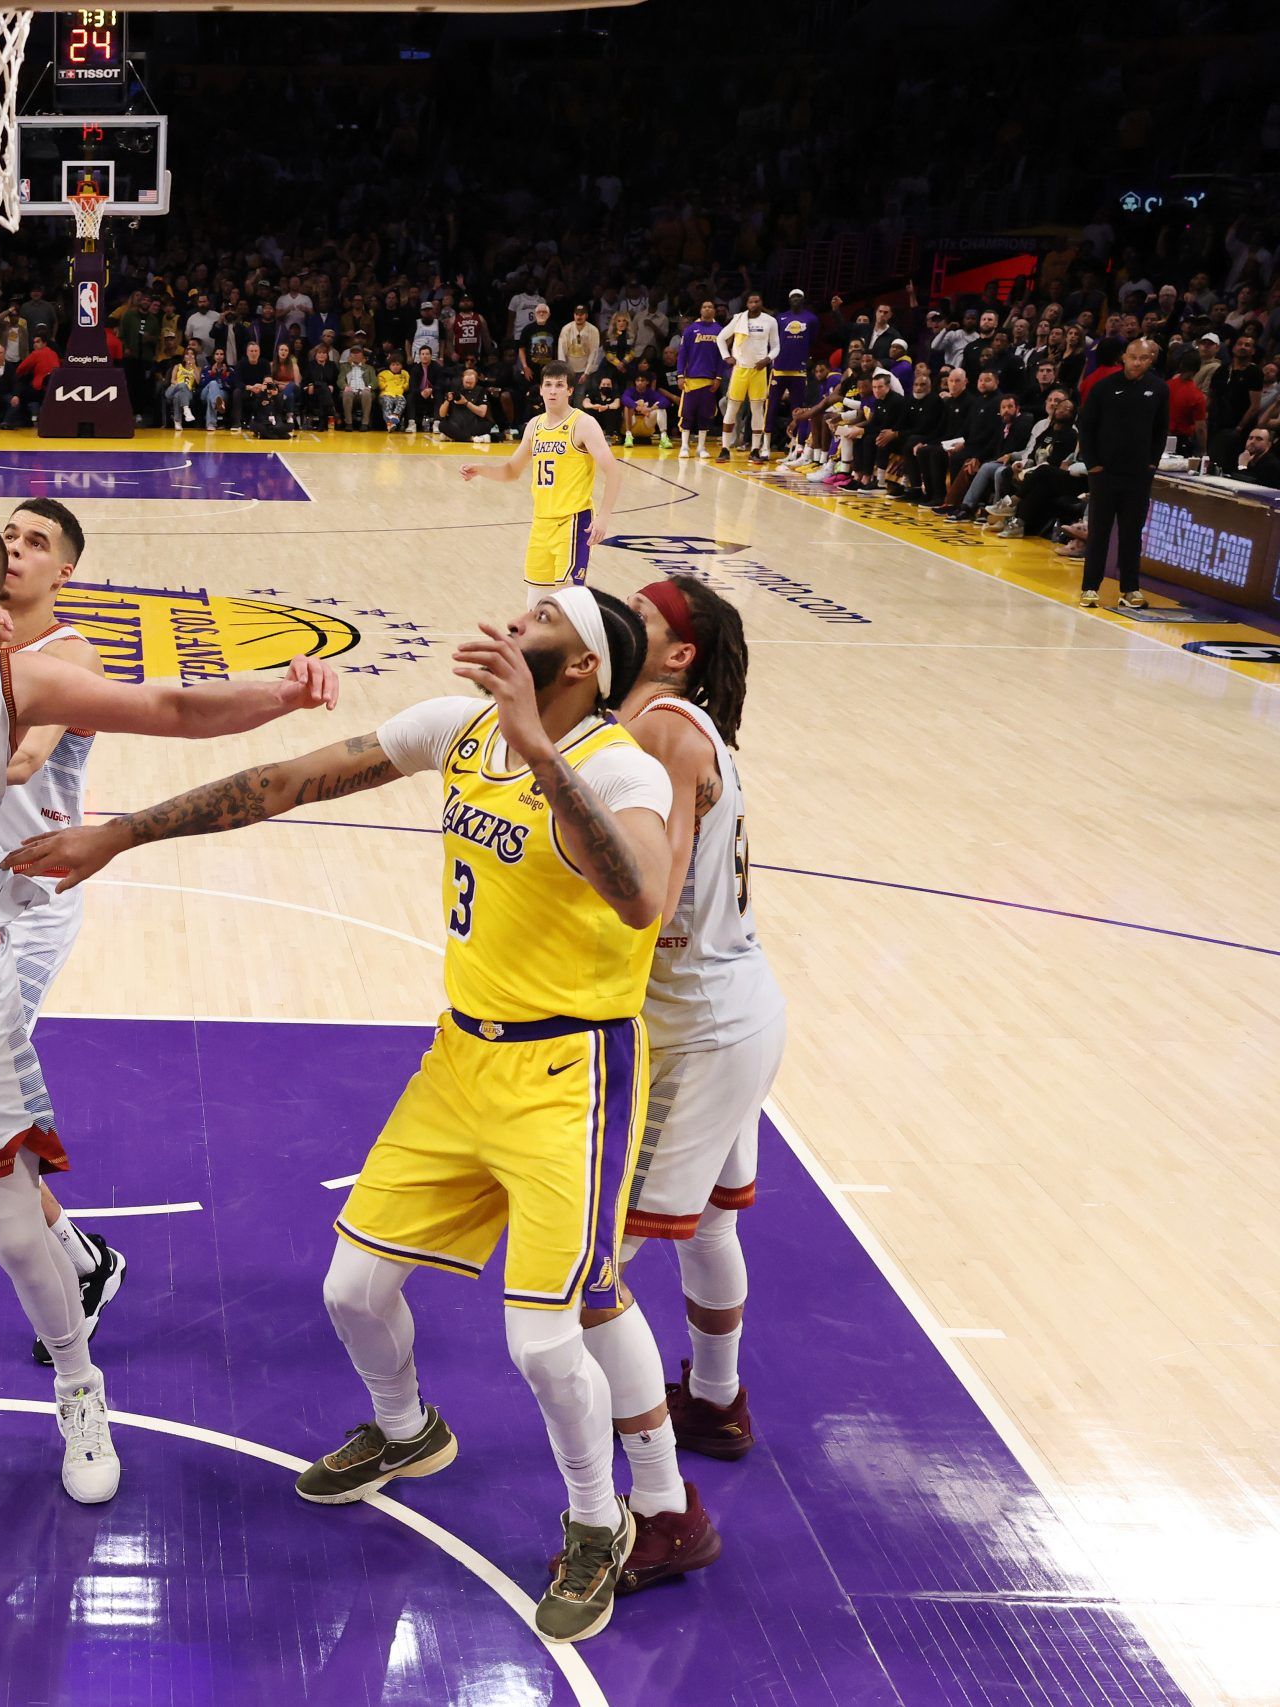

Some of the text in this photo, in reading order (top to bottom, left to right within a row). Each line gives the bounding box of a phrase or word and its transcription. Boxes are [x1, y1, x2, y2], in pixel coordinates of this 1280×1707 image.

[78, 9, 117, 27] 7:31
[69, 28, 111, 62] 24
[76, 69, 121, 79] TISSOT
[461, 326, 476, 338] 33
[68, 355, 108, 364] Google Pixel
[532, 439, 567, 456] LAKERS
[536, 459, 555, 488] 15
[463, 741, 476, 757] 6
[517, 792, 545, 811] bibigo
[442, 785, 531, 865] LAKERS
[447, 857, 477, 943] 3
